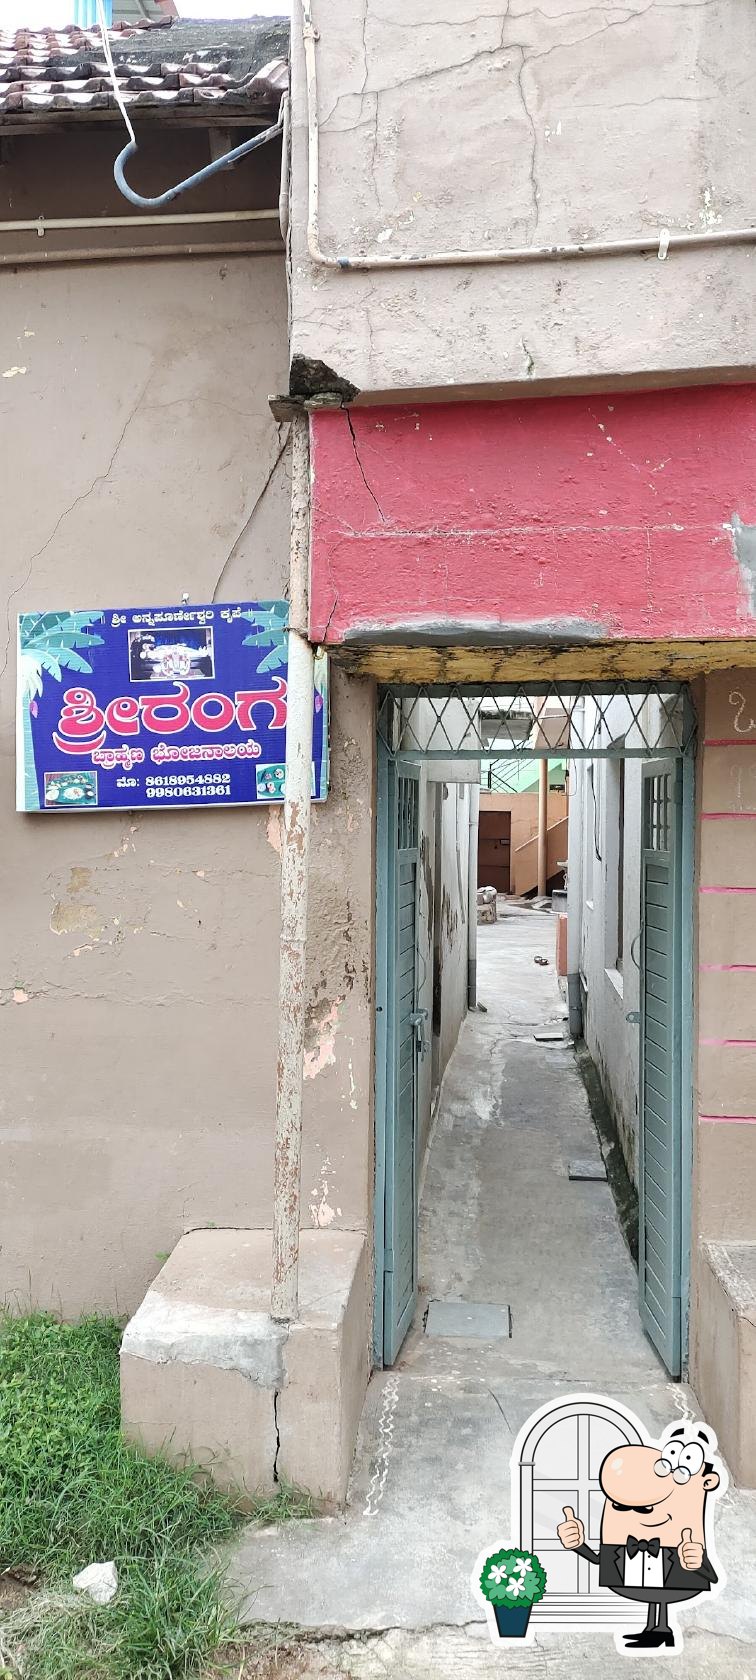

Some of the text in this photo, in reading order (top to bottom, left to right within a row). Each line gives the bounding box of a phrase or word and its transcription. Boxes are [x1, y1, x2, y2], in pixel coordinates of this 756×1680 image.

[111, 613, 127, 627] ಶ್ರೀ
[220, 607, 242, 623] ಕೃಪೆ
[53, 676, 287, 755] ಶ್ರೀರಂಗ
[92, 739, 262, 769] ಬ್ರಾಹ್ಮಣ ಭೋಜನಾಲಯ
[145, 773, 231, 787] 8618954882
[145, 784, 231, 798] 9980631361
